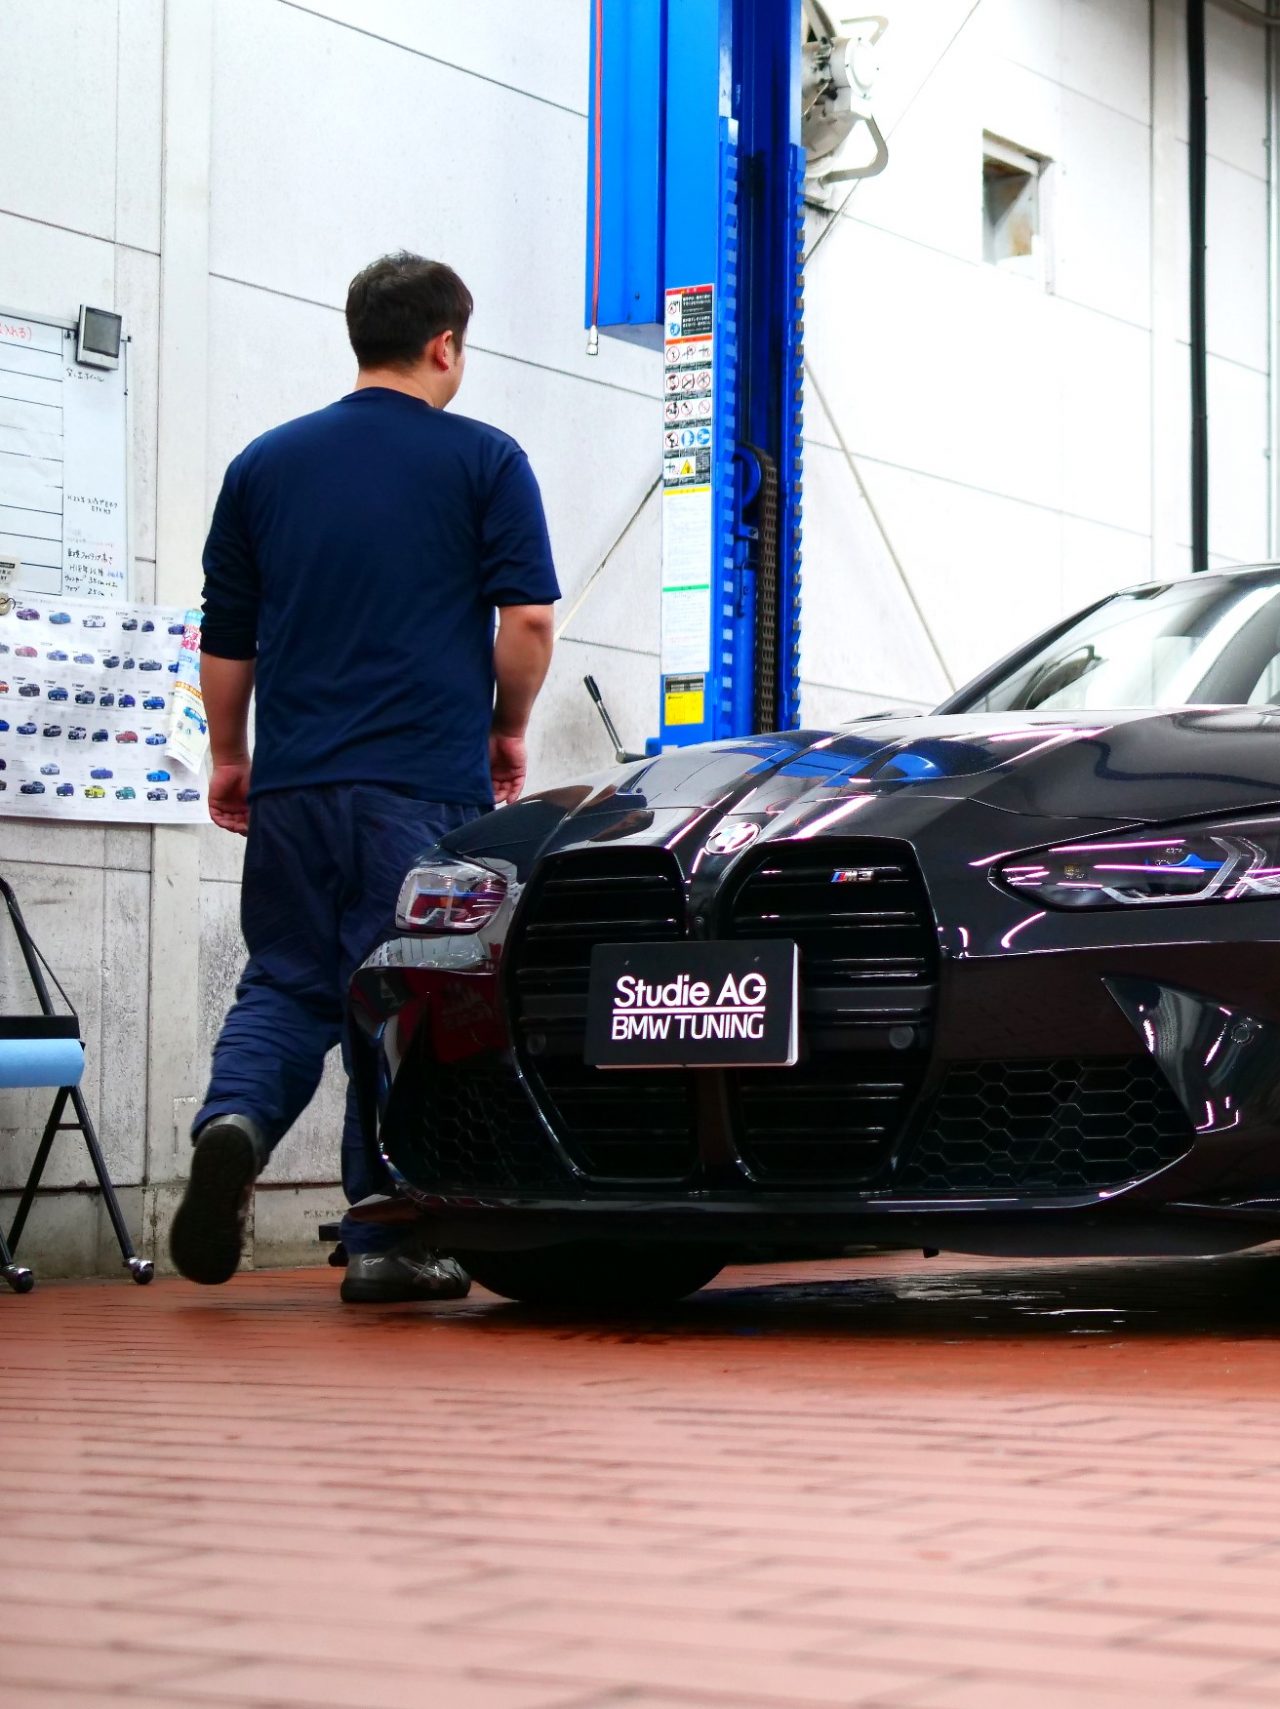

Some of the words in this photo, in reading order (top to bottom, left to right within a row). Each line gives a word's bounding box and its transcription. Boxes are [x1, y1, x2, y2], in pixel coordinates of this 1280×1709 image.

[844, 869, 874, 882] M3
[613, 974, 710, 1008] Studie
[716, 972, 768, 1006] AG
[611, 1013, 673, 1041] BMW
[674, 1013, 764, 1040] TUNING
